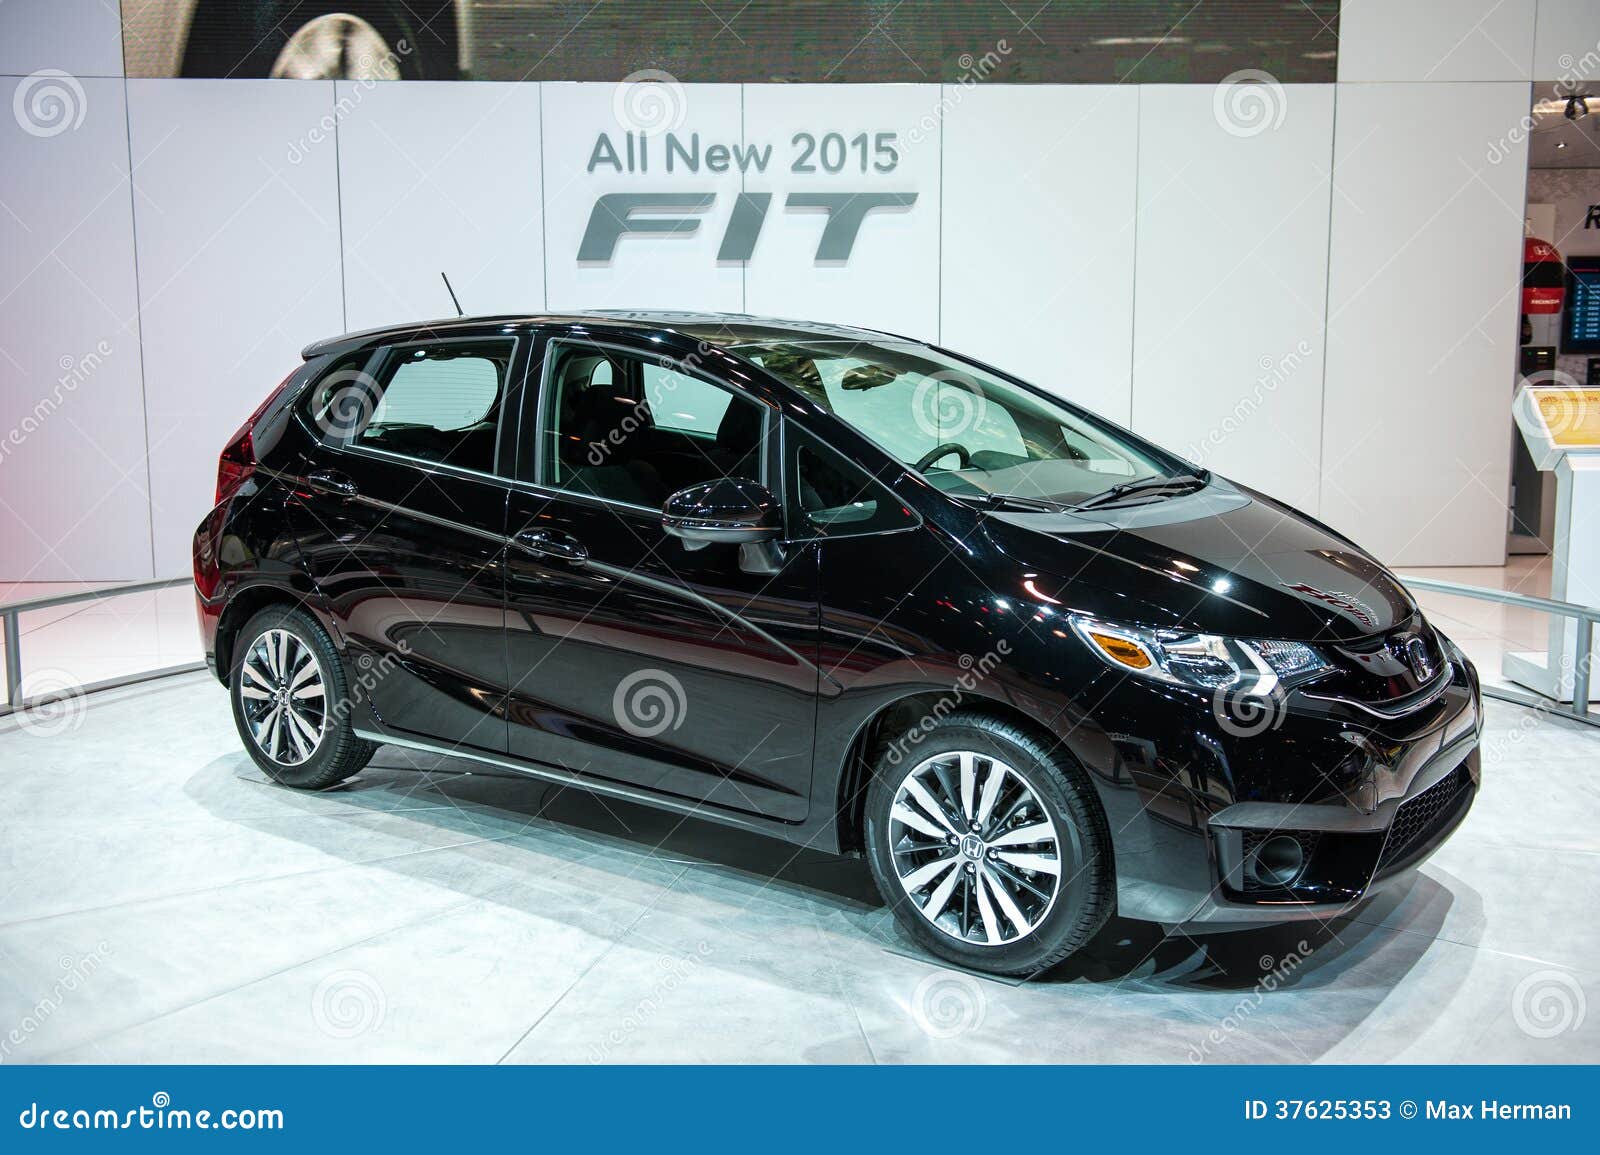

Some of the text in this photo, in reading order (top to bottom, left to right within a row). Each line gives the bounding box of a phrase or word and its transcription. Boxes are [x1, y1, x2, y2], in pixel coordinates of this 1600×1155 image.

[587, 131, 899, 173] All New 2015
[576, 192, 919, 261] FIT
